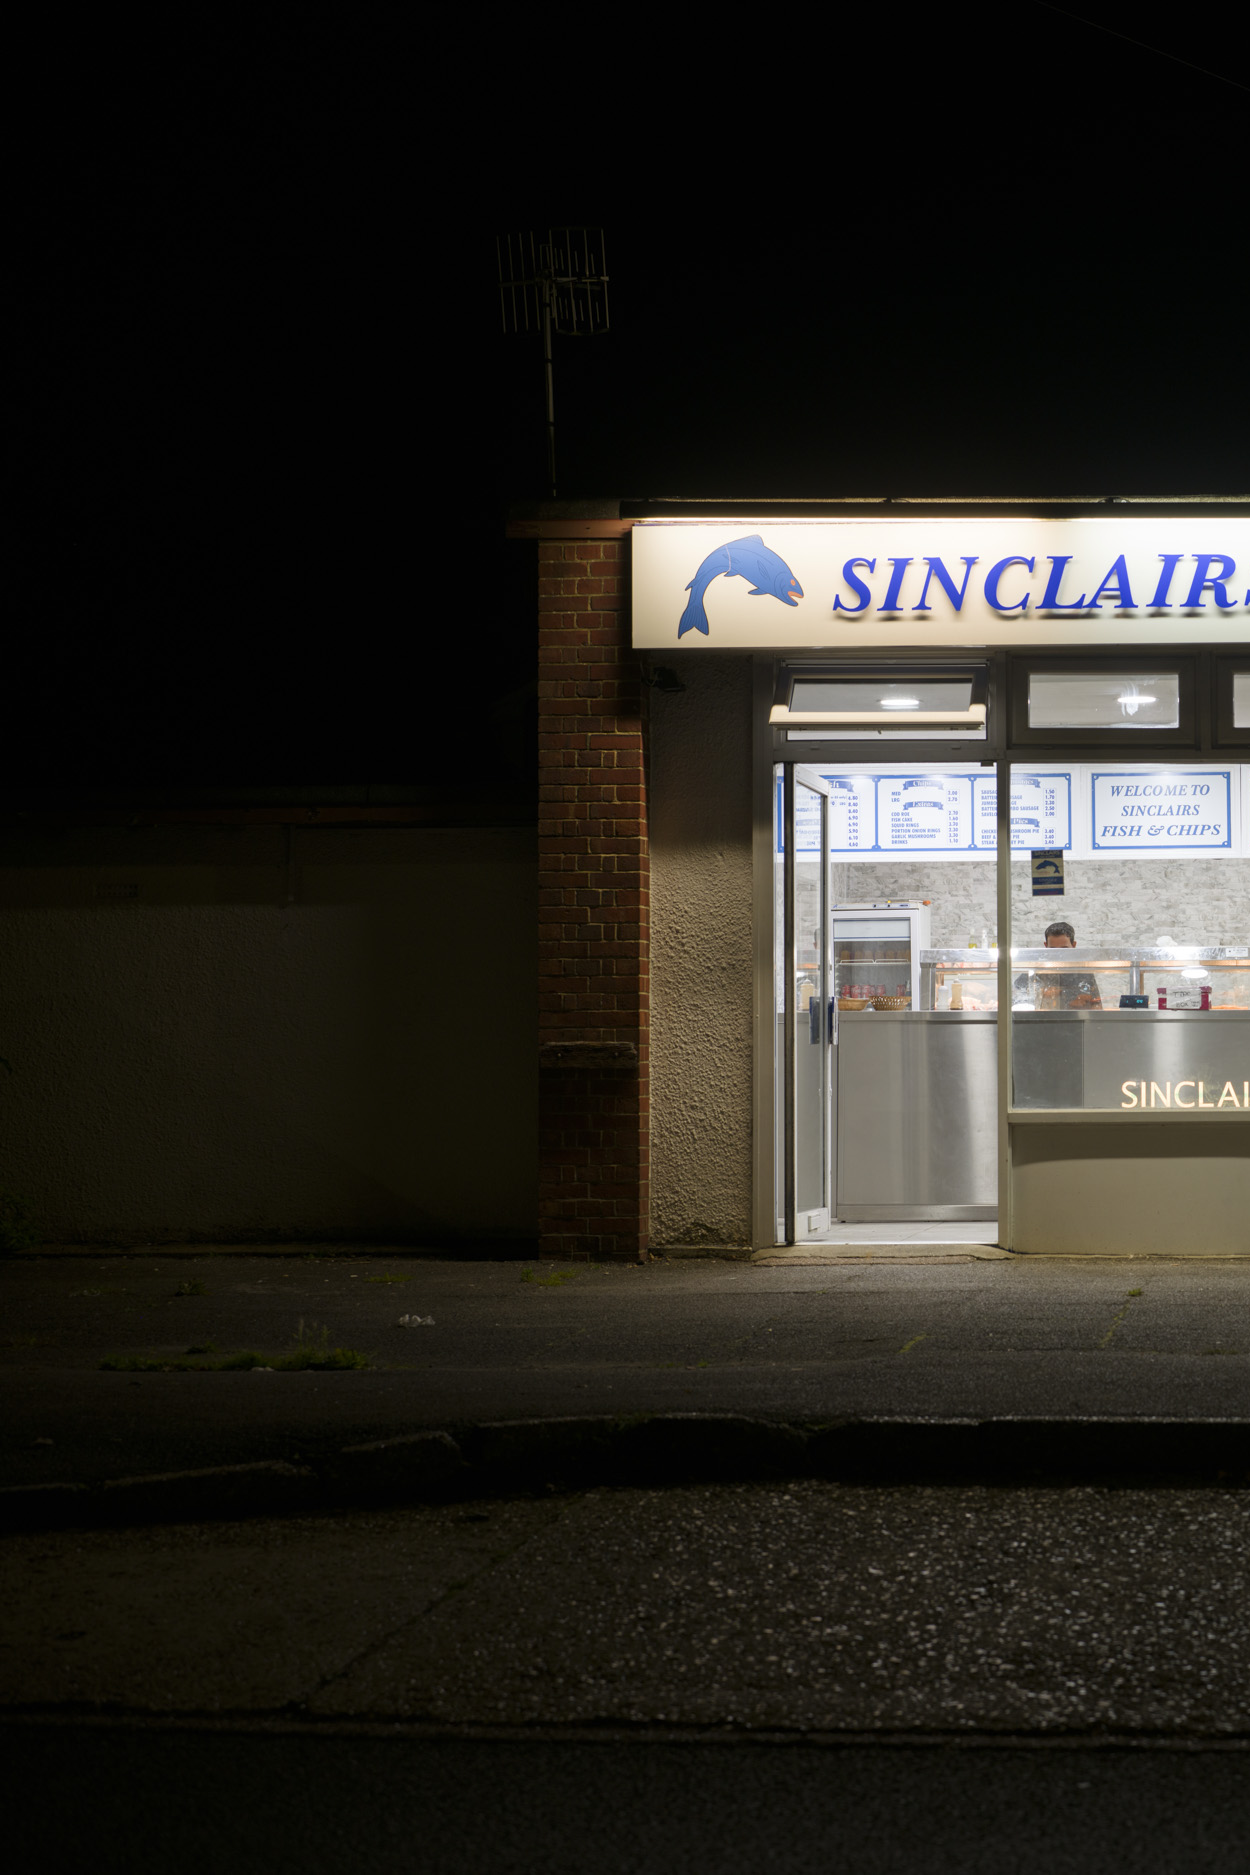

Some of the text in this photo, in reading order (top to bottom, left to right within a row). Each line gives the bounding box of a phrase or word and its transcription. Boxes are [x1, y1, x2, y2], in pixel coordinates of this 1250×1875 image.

[1111, 784, 1210, 797] WELCOME TO
[1121, 804, 1200, 816] SINCLAIRS
[1101, 824, 1221, 836] FISH & CHIPS
